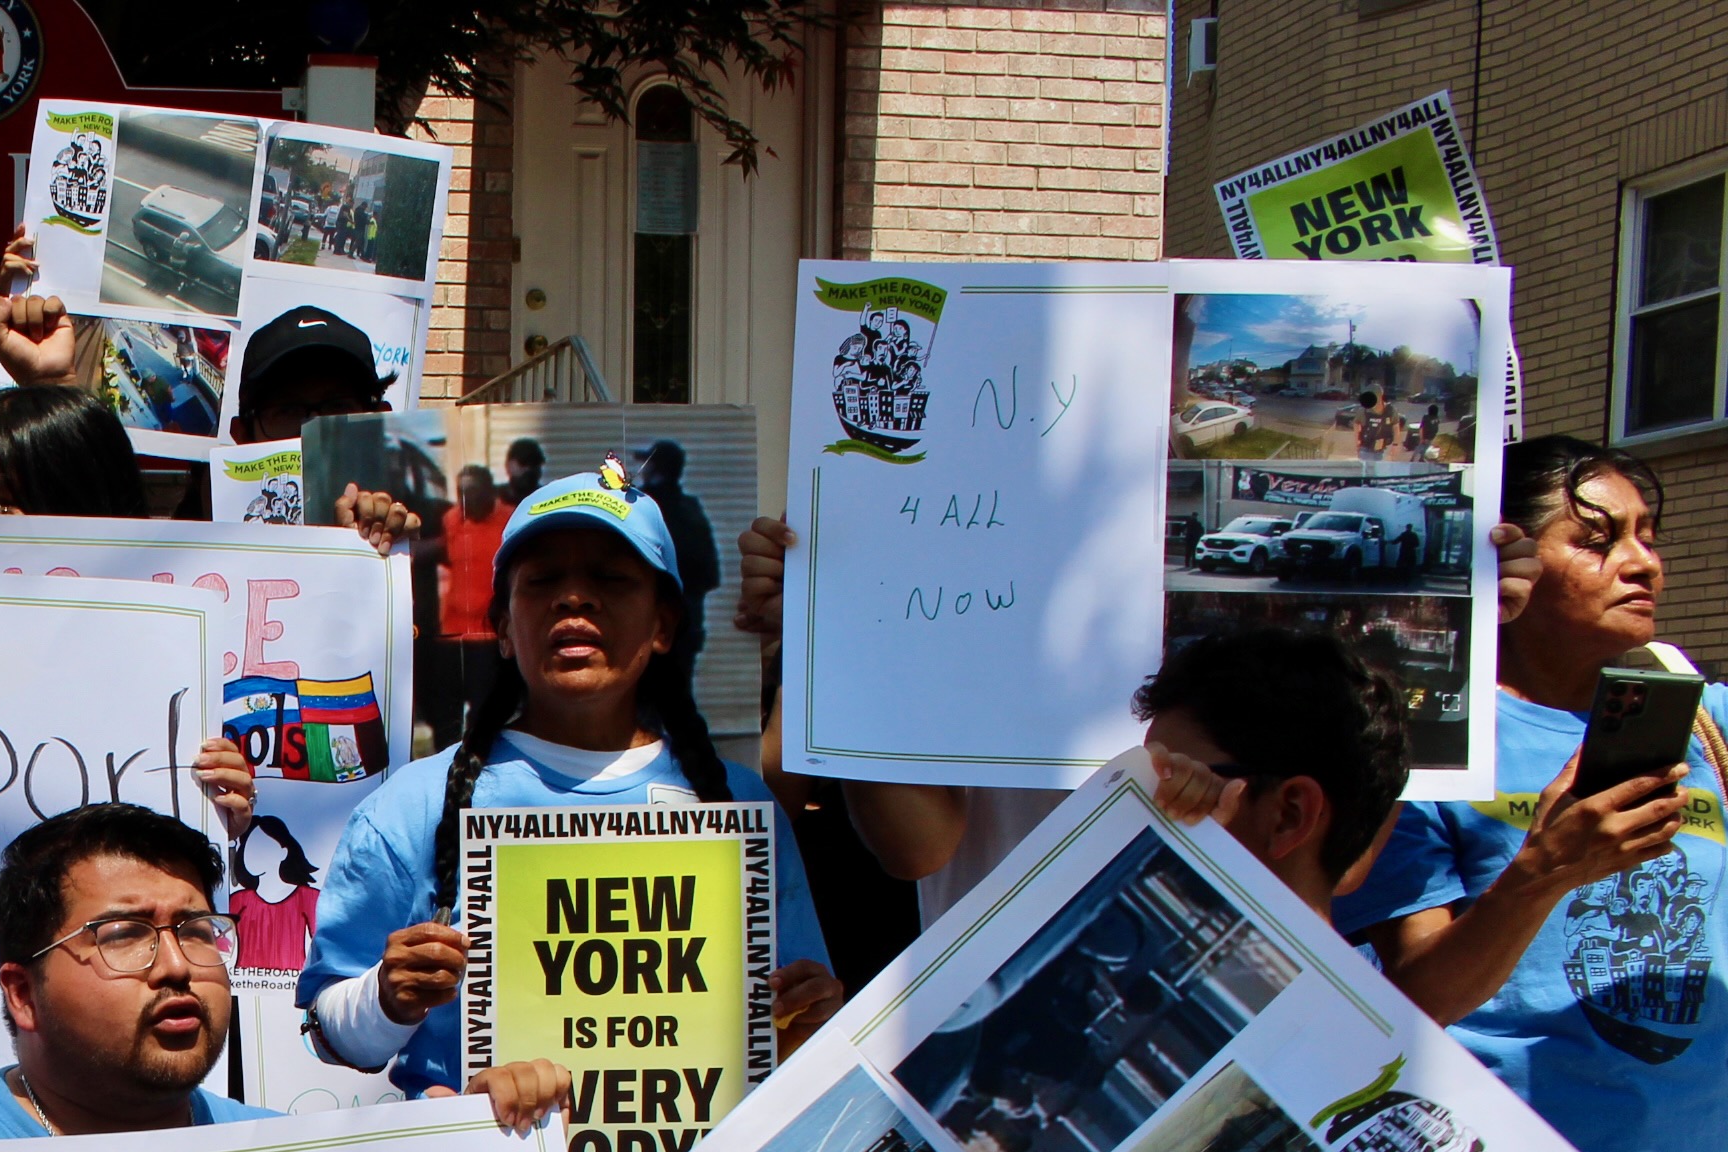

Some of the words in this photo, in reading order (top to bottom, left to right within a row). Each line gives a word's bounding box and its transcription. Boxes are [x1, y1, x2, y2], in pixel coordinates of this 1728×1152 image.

[3, 57, 36, 102] YORK
[53, 116, 77, 125] MAKE
[78, 115, 97, 123] THE
[98, 116, 114, 126] ROA
[83, 123, 101, 131] NEW
[1220, 98, 1447, 201] NY4ALLNY4ALLNY4ALL
[1290, 166, 1409, 238] NEW
[1292, 204, 1433, 261] YORK
[827, 286, 867, 300] MAKE
[869, 281, 898, 295] THE
[901, 282, 943, 304] ROAD
[879, 296, 905, 306] NEW
[908, 297, 937, 316] YORK
[373, 342, 410, 366] YORK
[234, 461, 265, 474] MAKE
[266, 454, 287, 467] THE
[273, 464, 294, 473] NEW
[538, 495, 569, 509] MAKE
[570, 491, 594, 499] THE
[596, 493, 627, 511] ROAD
[602, 501, 624, 515] YORK
[899, 496, 920, 525] 4
[940, 490, 1005, 529] ALL
[905, 581, 1015, 621] NOW
[466, 809, 768, 840] NY4ALLNY4ALLNY4ALL
[1680, 815, 1716, 832] ORK
[545, 875, 697, 934] NEW
[532, 937, 709, 996] YORK
[563, 1017, 598, 1049] IS
[607, 1015, 679, 1047] FOR
[569, 1067, 724, 1125] VERY
